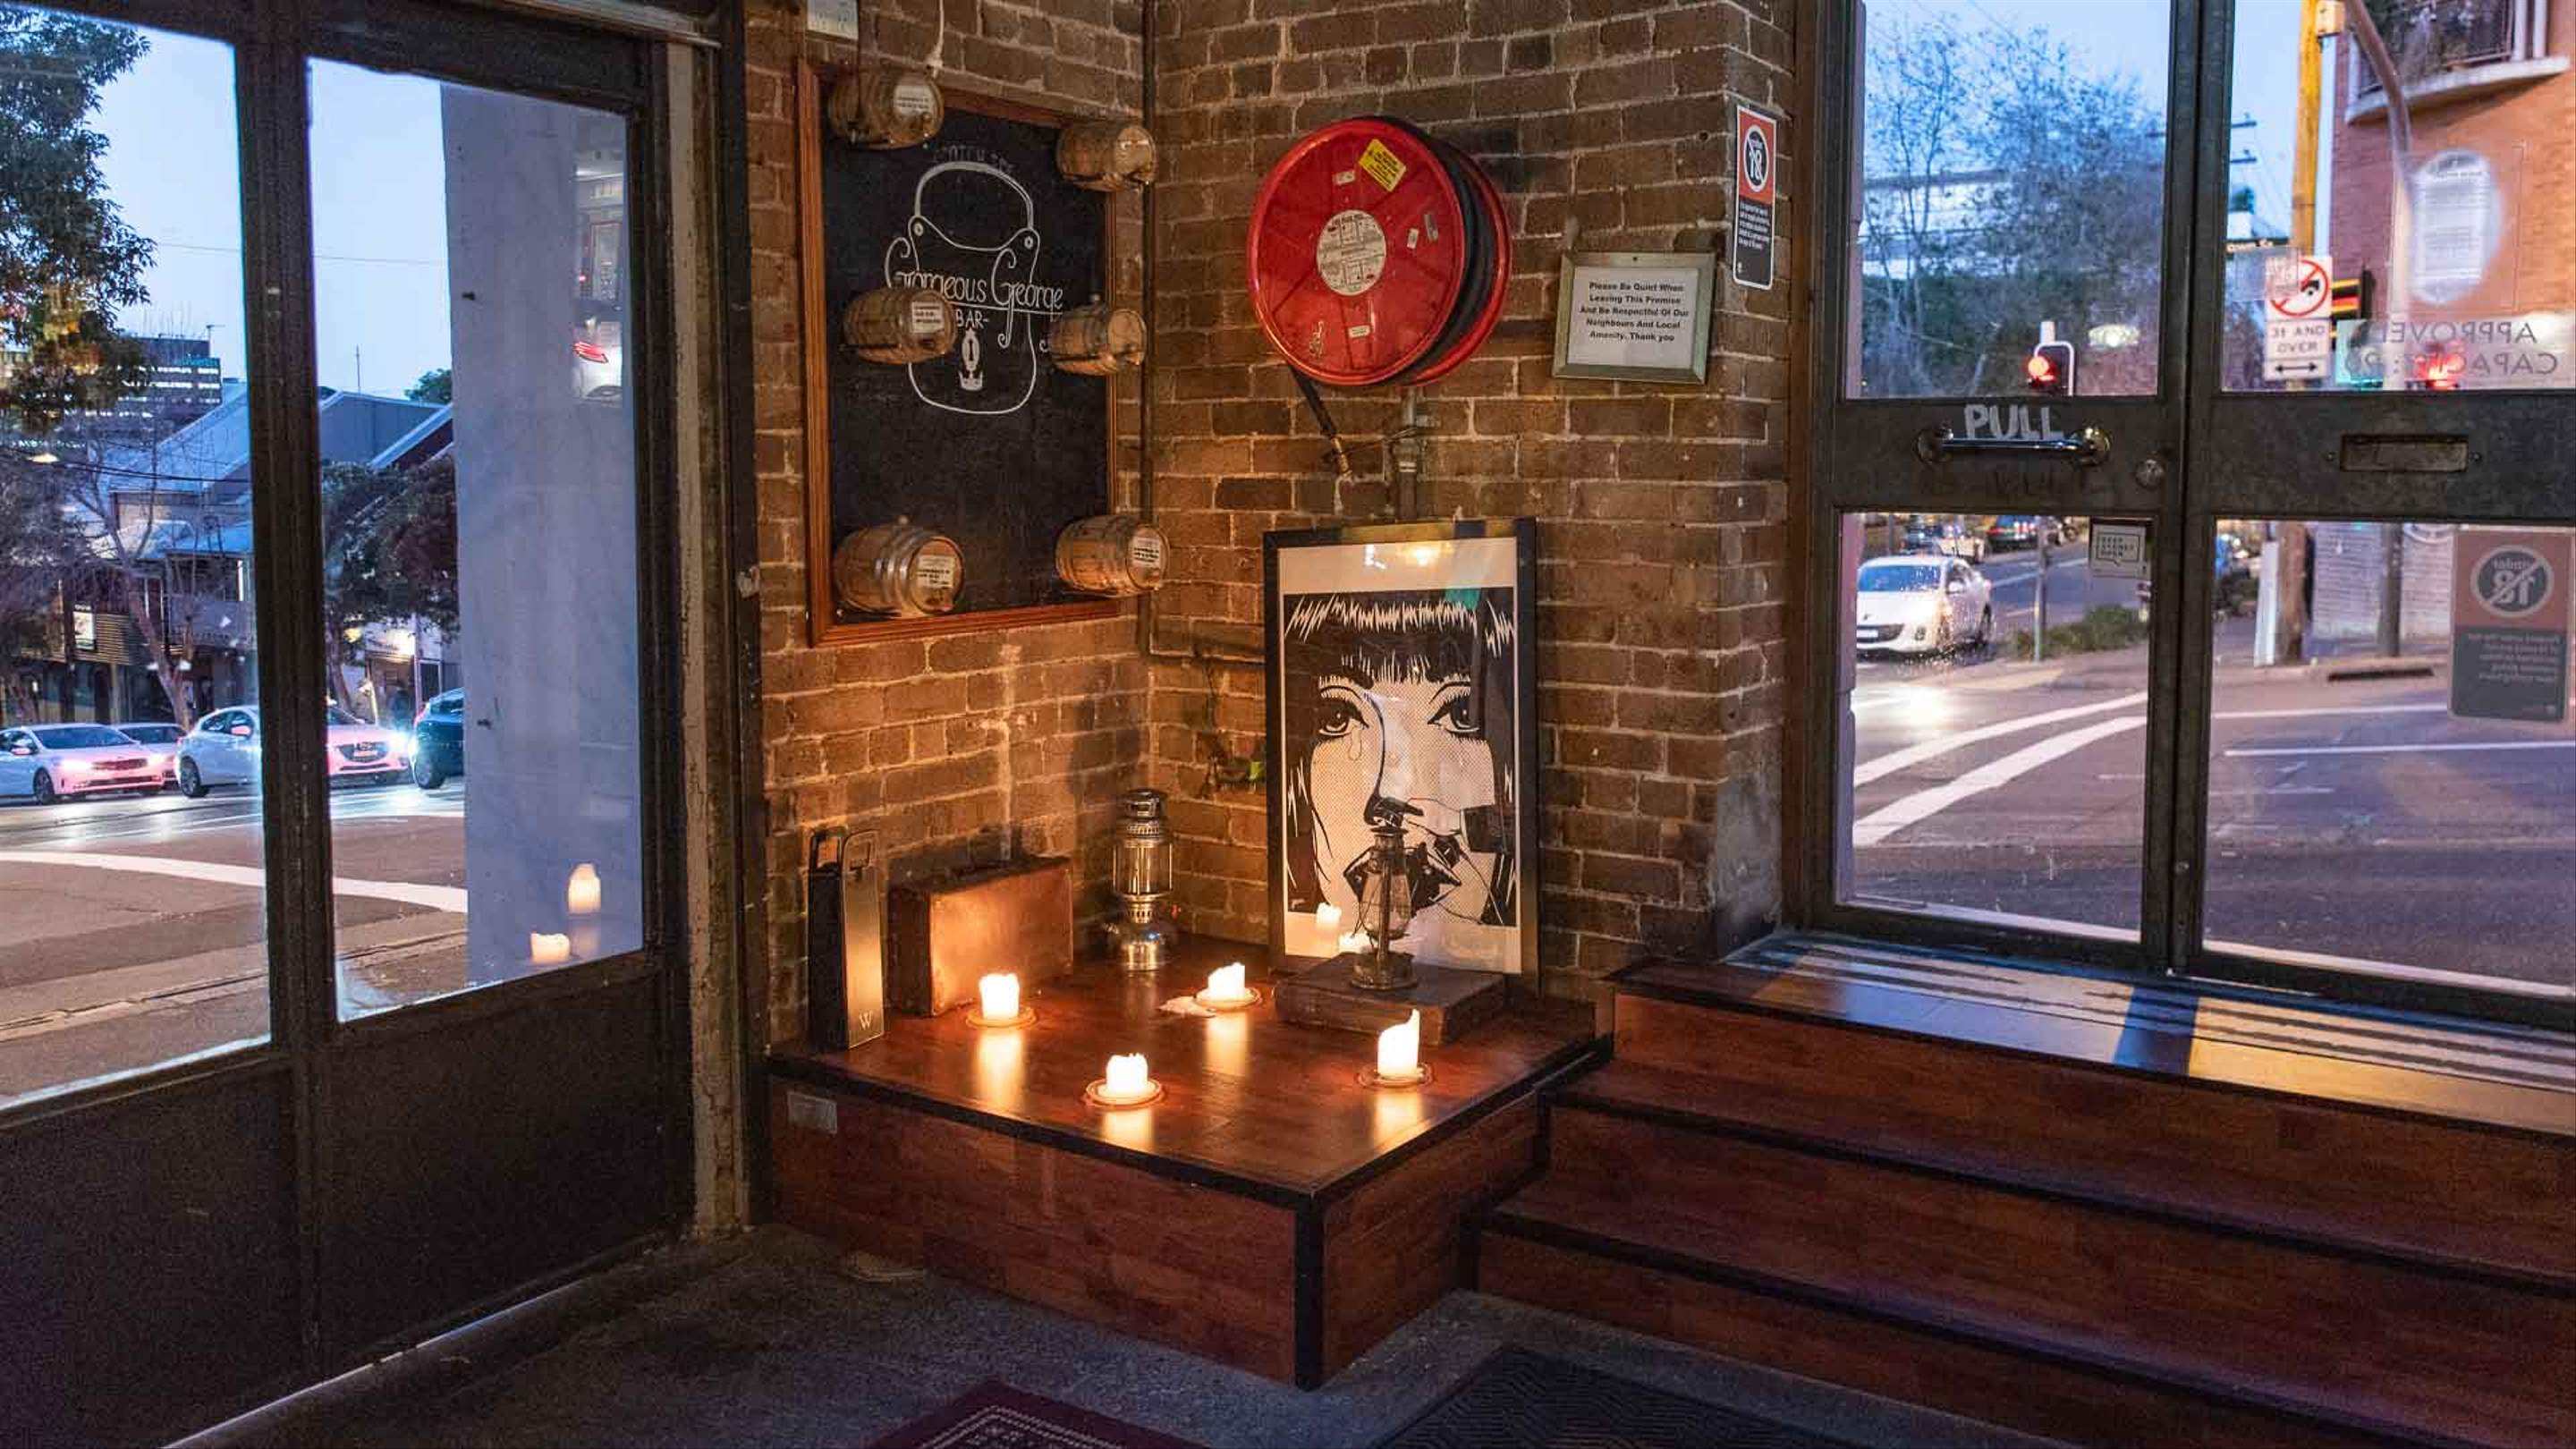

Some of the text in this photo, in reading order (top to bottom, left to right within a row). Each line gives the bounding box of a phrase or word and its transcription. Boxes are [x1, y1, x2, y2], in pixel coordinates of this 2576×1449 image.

[991, 249, 1063, 347] George
[1589, 295, 1623, 304] Leaving
[1646, 296, 1681, 304] Premise
[1580, 305, 1597, 313] And
[1613, 307, 1657, 317] Respectful
[1587, 318, 1634, 327] Neighbours
[1637, 319, 1654, 328] And
[2295, 326, 2325, 336] AND
[1630, 332, 1656, 341] Thank
[1658, 335, 1674, 343] you
[2277, 341, 2318, 353] OVER
[1964, 403, 2063, 440] PULL
[859, 1010, 873, 1030] W
